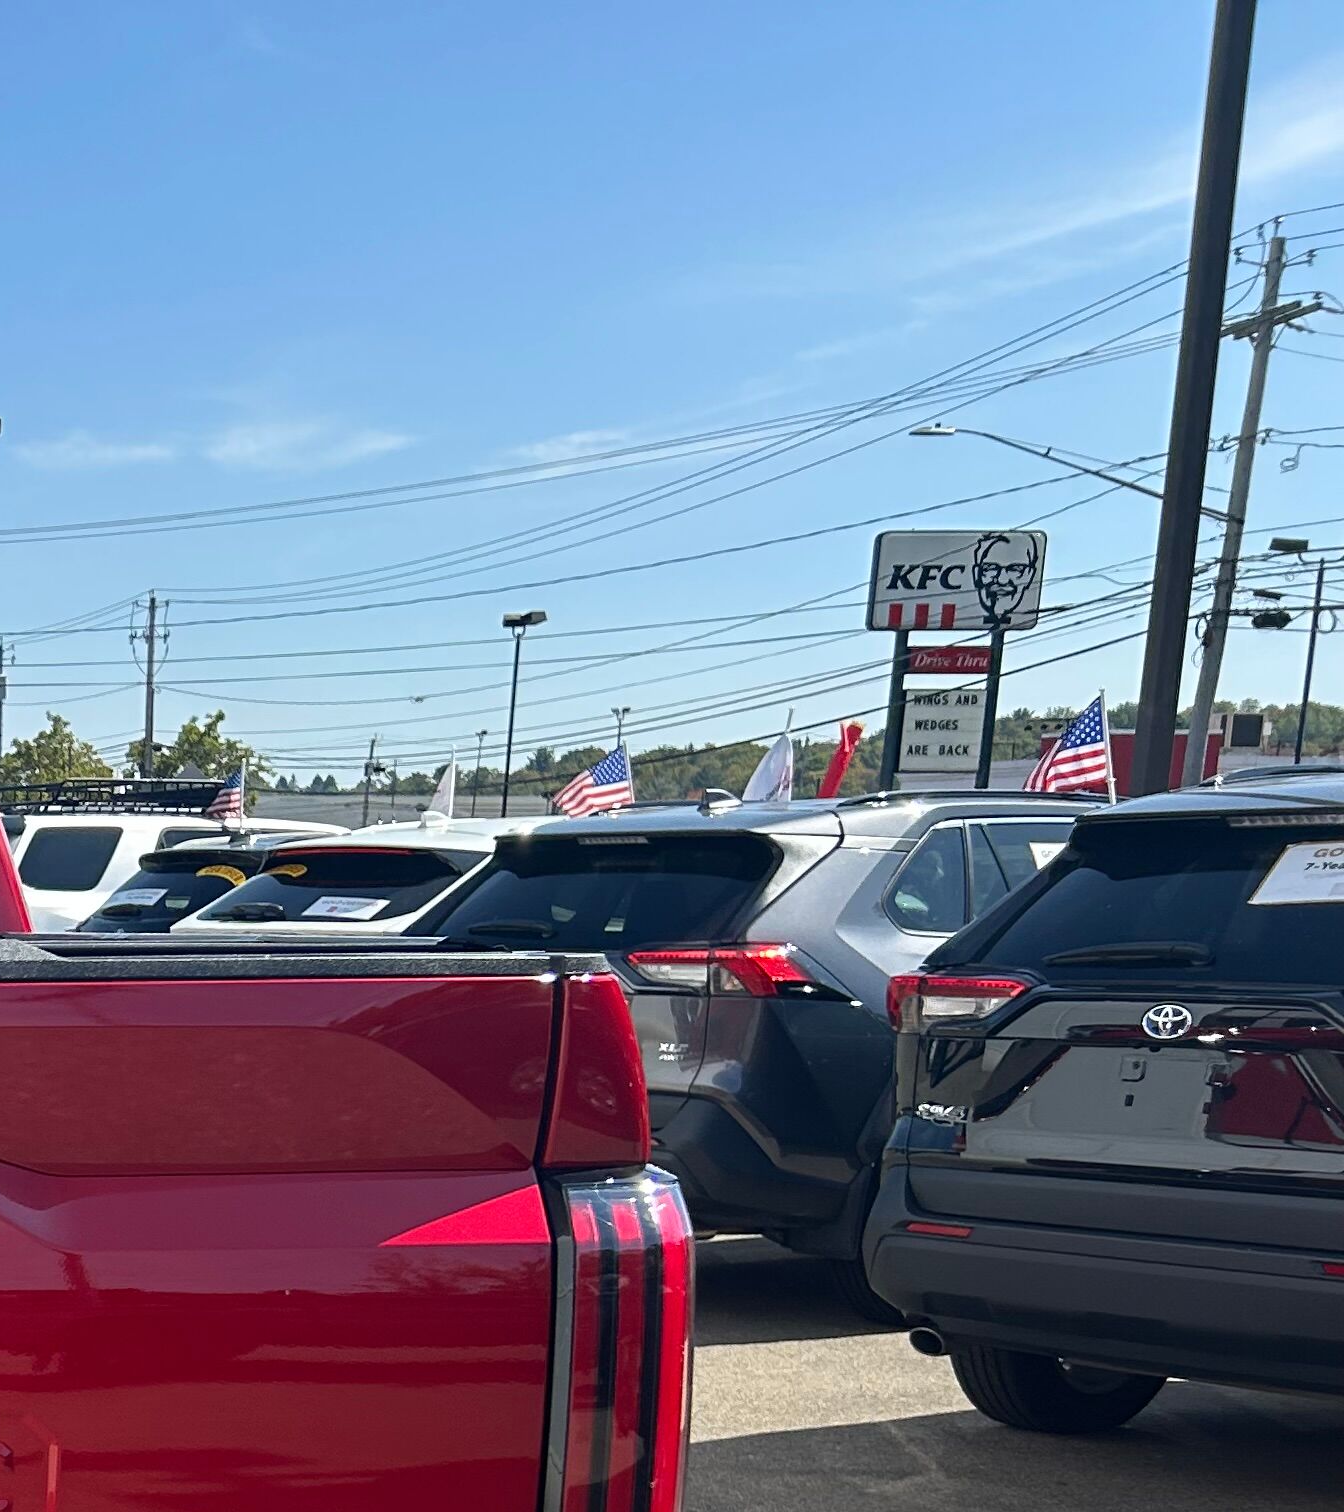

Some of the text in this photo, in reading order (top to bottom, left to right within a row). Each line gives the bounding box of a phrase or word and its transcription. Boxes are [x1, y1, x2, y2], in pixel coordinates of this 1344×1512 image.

[886, 564, 965, 590] KFC
[914, 653, 988, 668] Drive Thru
[913, 694, 978, 706] WINGS AND
[914, 719, 959, 731] WEDGES
[907, 744, 969, 756] ARE BACK
